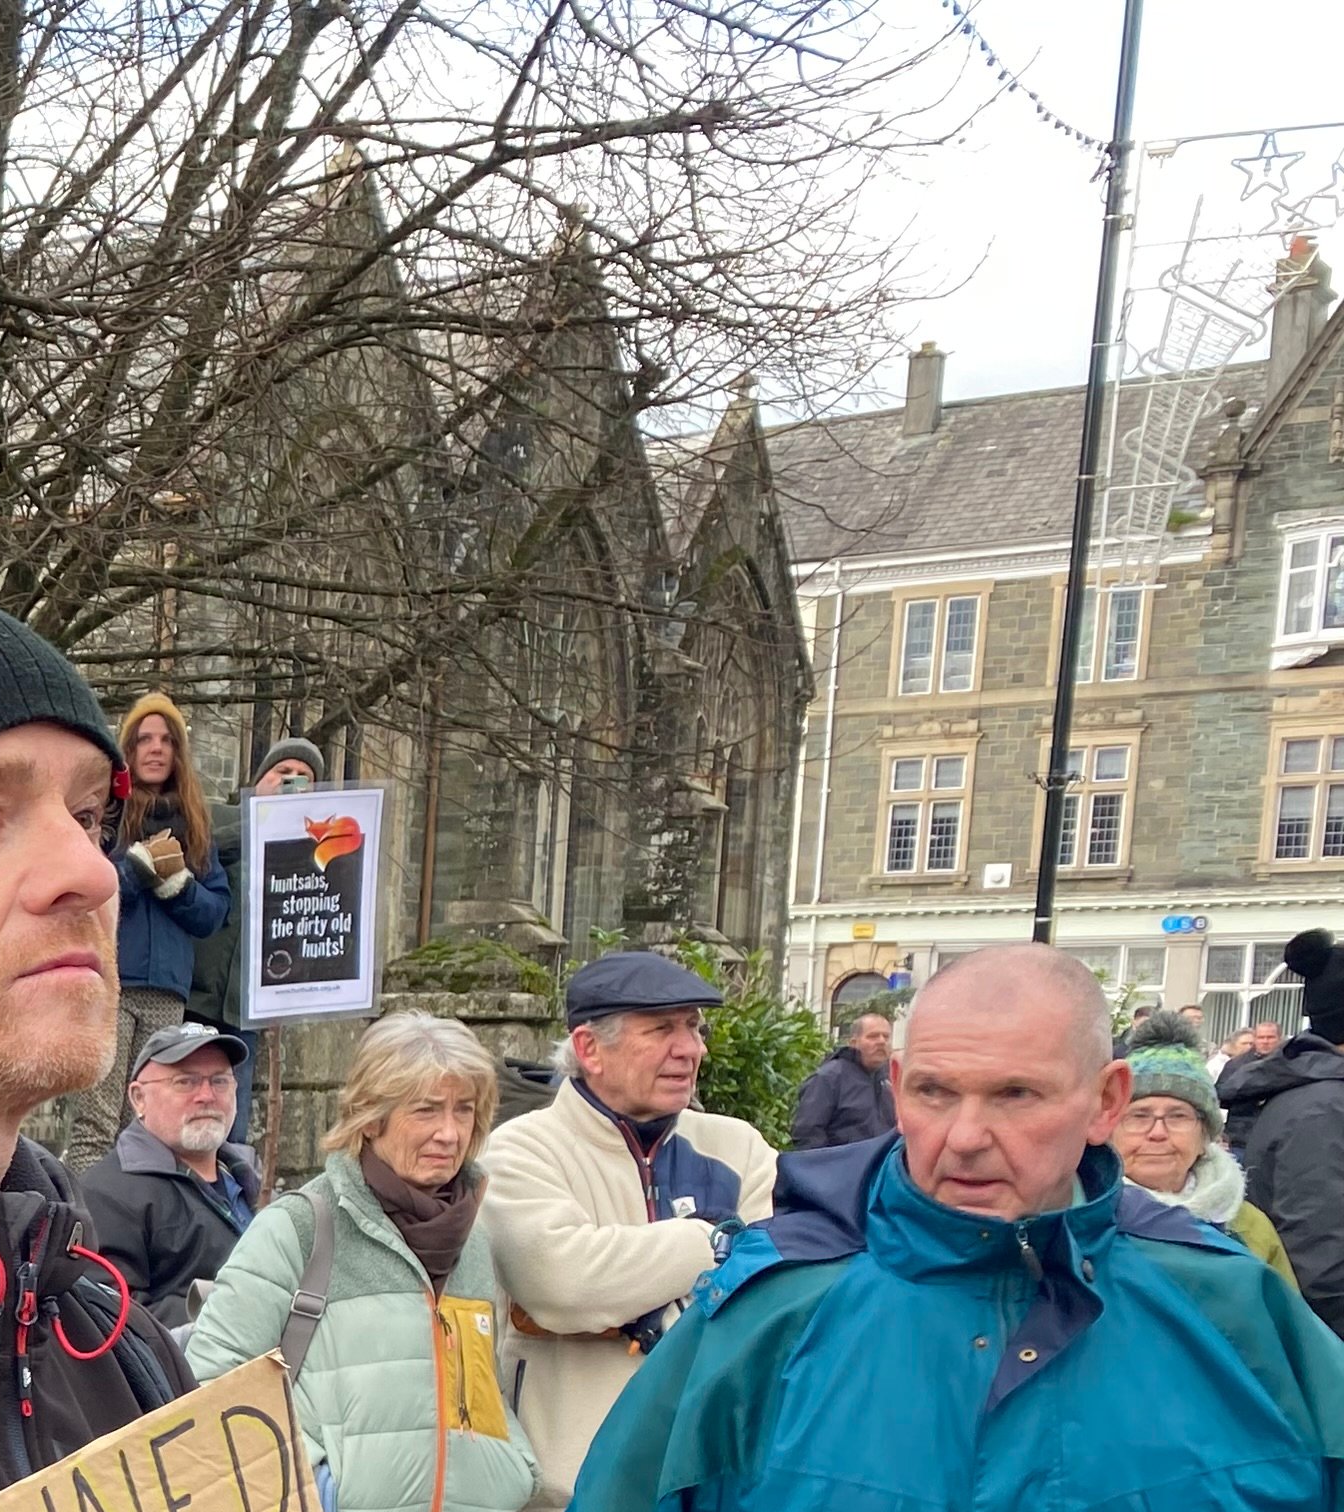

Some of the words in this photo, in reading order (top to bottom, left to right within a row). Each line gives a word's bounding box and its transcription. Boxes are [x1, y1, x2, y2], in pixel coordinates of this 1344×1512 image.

[283, 893, 340, 915] stopping
[272, 919, 293, 939] the
[297, 916, 328, 937] dirty
[331, 912, 352, 933] old
[302, 936, 344, 958] hunts!
